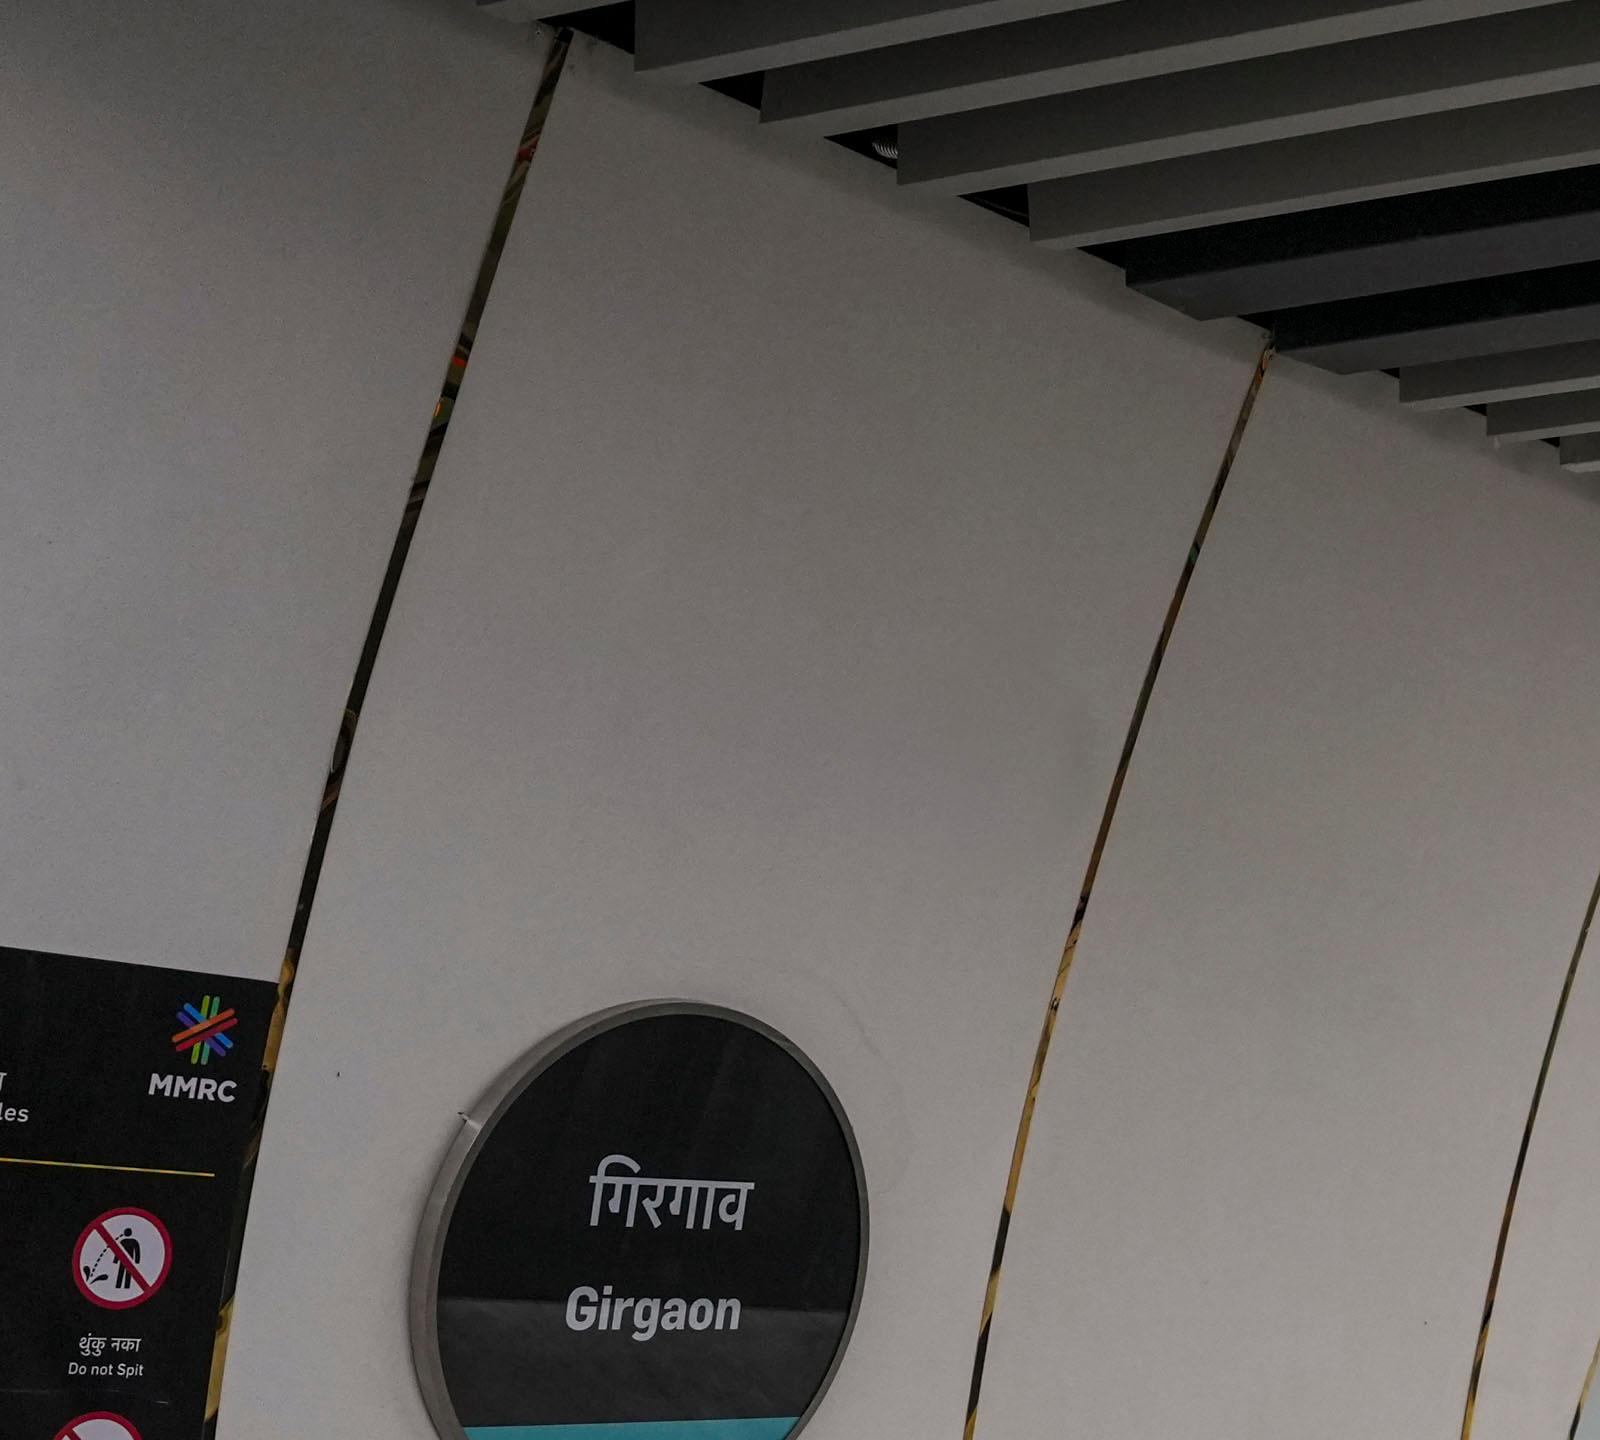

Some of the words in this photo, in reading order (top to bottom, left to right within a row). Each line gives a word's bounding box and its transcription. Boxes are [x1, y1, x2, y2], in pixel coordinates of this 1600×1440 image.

[148, 1073, 237, 1103] MMRC
[589, 1154, 755, 1231] गिरगाव
[565, 1285, 742, 1342] Girgaon
[111, 1337, 142, 1353] नका
[68, 1362, 87, 1376] Do
[91, 1364, 113, 1376] not
[117, 1363, 144, 1380] Spit
